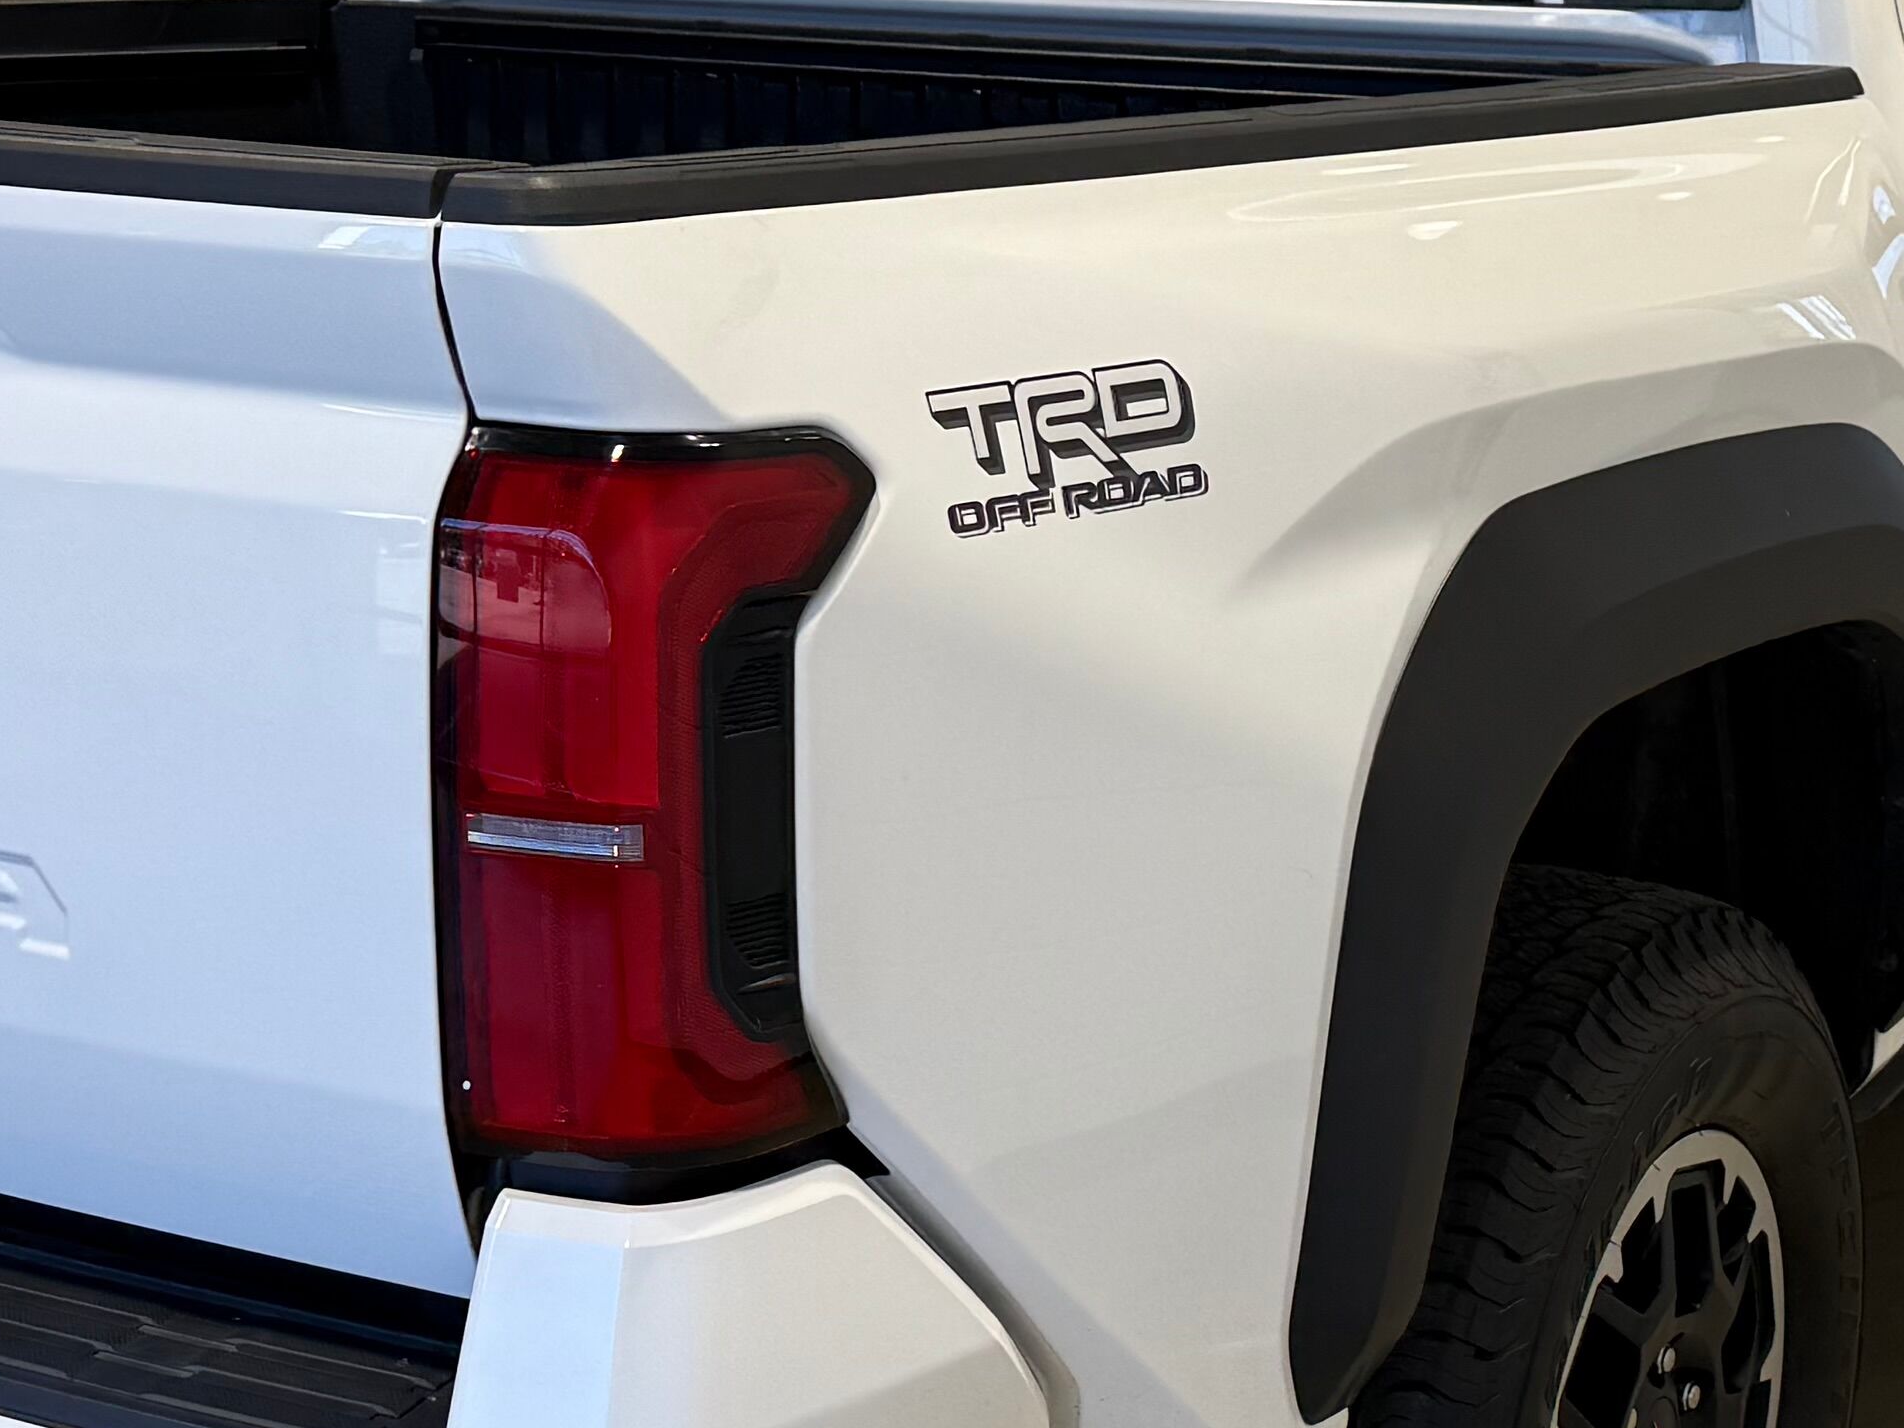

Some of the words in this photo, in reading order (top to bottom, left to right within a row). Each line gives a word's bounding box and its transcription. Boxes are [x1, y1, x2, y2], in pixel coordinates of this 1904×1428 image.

[925, 358, 1195, 488] TRD
[947, 488, 1056, 539] OFF
[1062, 463, 1209, 520] ROAD
